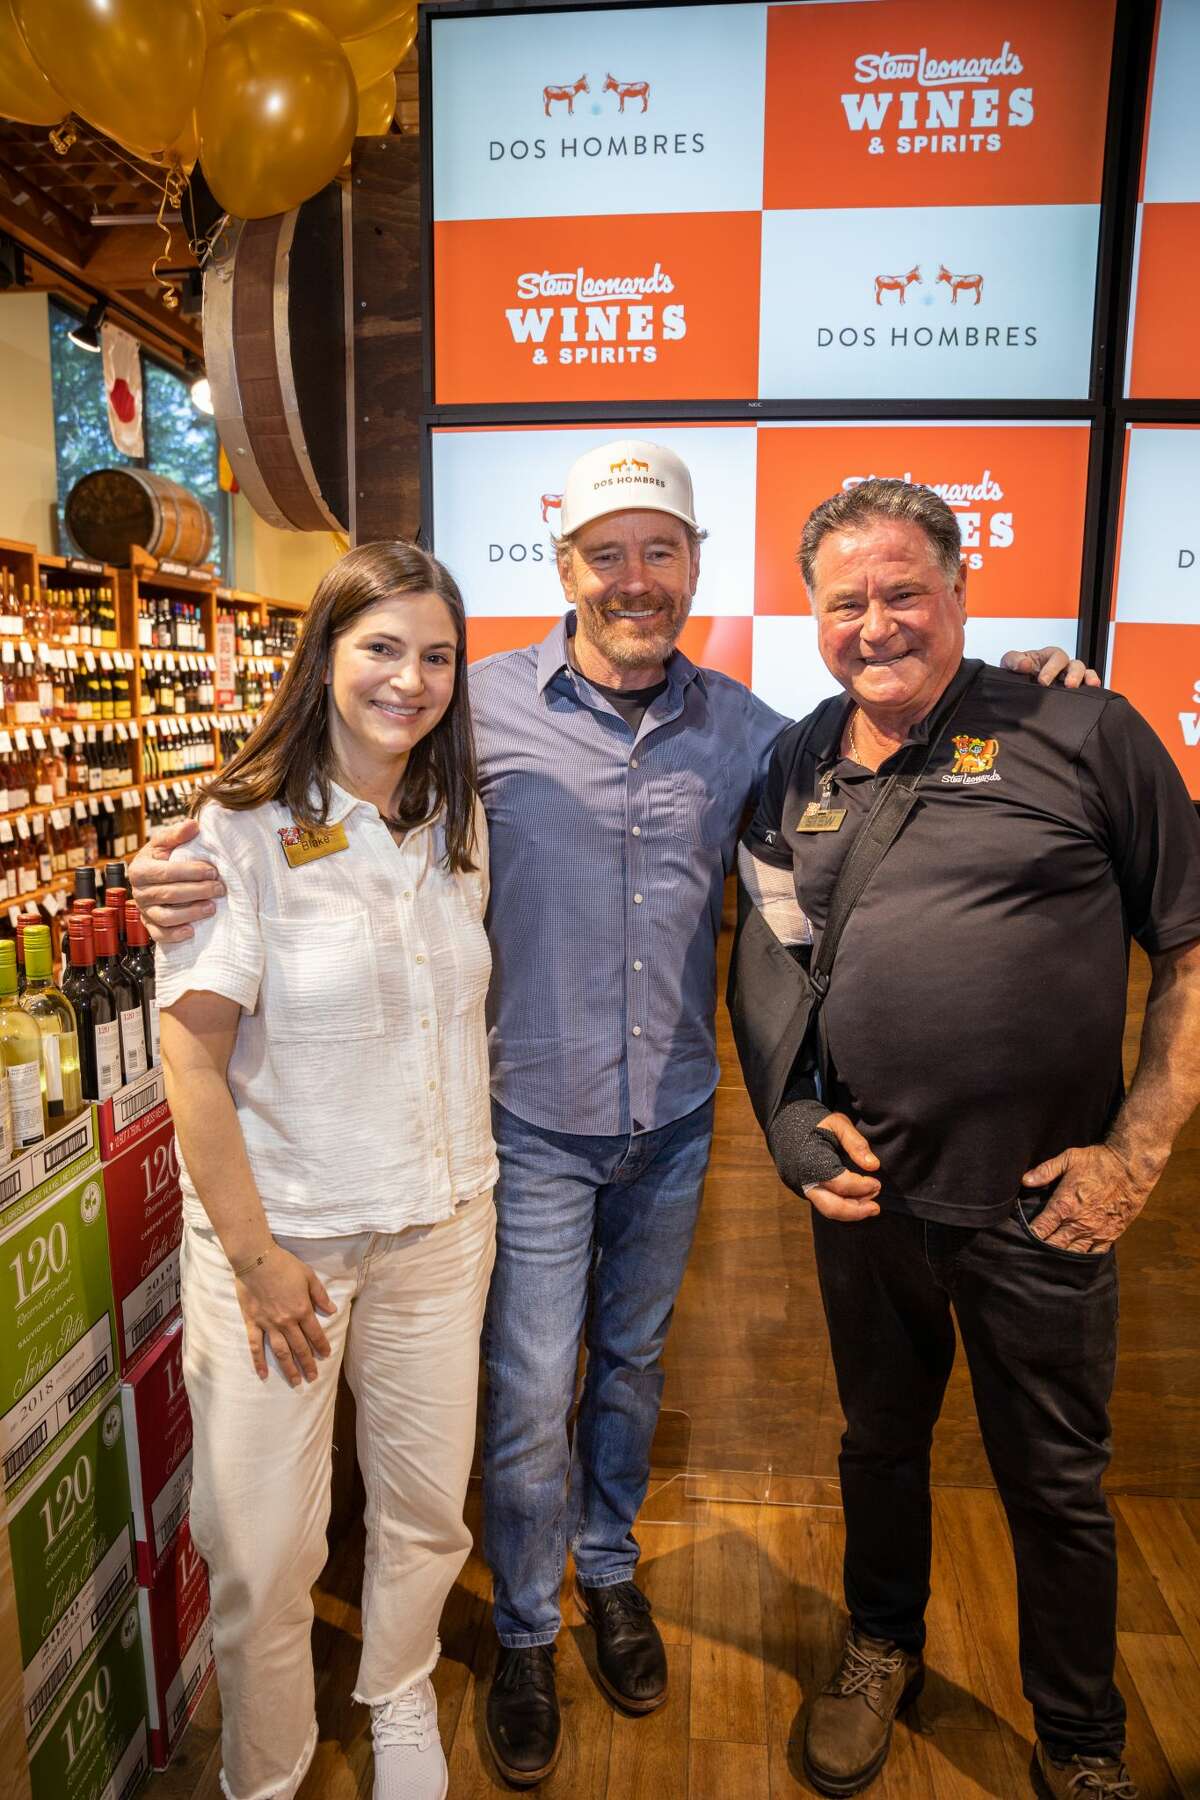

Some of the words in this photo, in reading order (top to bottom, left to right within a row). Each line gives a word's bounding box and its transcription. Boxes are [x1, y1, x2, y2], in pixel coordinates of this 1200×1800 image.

[854, 51, 918, 84] Stew
[917, 40, 1024, 87] Leonard's
[840, 87, 1034, 131] WINES
[489, 139, 546, 161] DOS
[561, 133, 705, 158] HOMBRES
[868, 136, 885, 155] &
[897, 133, 1001, 154] SPIRITS
[517, 270, 577, 300] Stew
[576, 262, 675, 303] Leonard's
[505, 304, 687, 343] WINES
[817, 327, 876, 347] DOS
[890, 326, 1038, 347] HOMBRES
[532, 348, 549, 365] &
[559, 346, 657, 365] SPIRITS
[594, 478, 613, 490] DOS
[617, 476, 665, 488] HOMBRES
[489, 543, 544, 562] DOS
[302, 835, 329, 852] Blake
[9, 1222, 68, 1309] 120
[17, 1313, 55, 1350] SAUVIGNON
[13, 1343, 53, 1400] Santa
[20, 1380, 54, 1422] 2018
[40, 1455, 91, 1553] 120
[42, 1600, 79, 1661] 2020
[61, 1665, 111, 1775] 120
